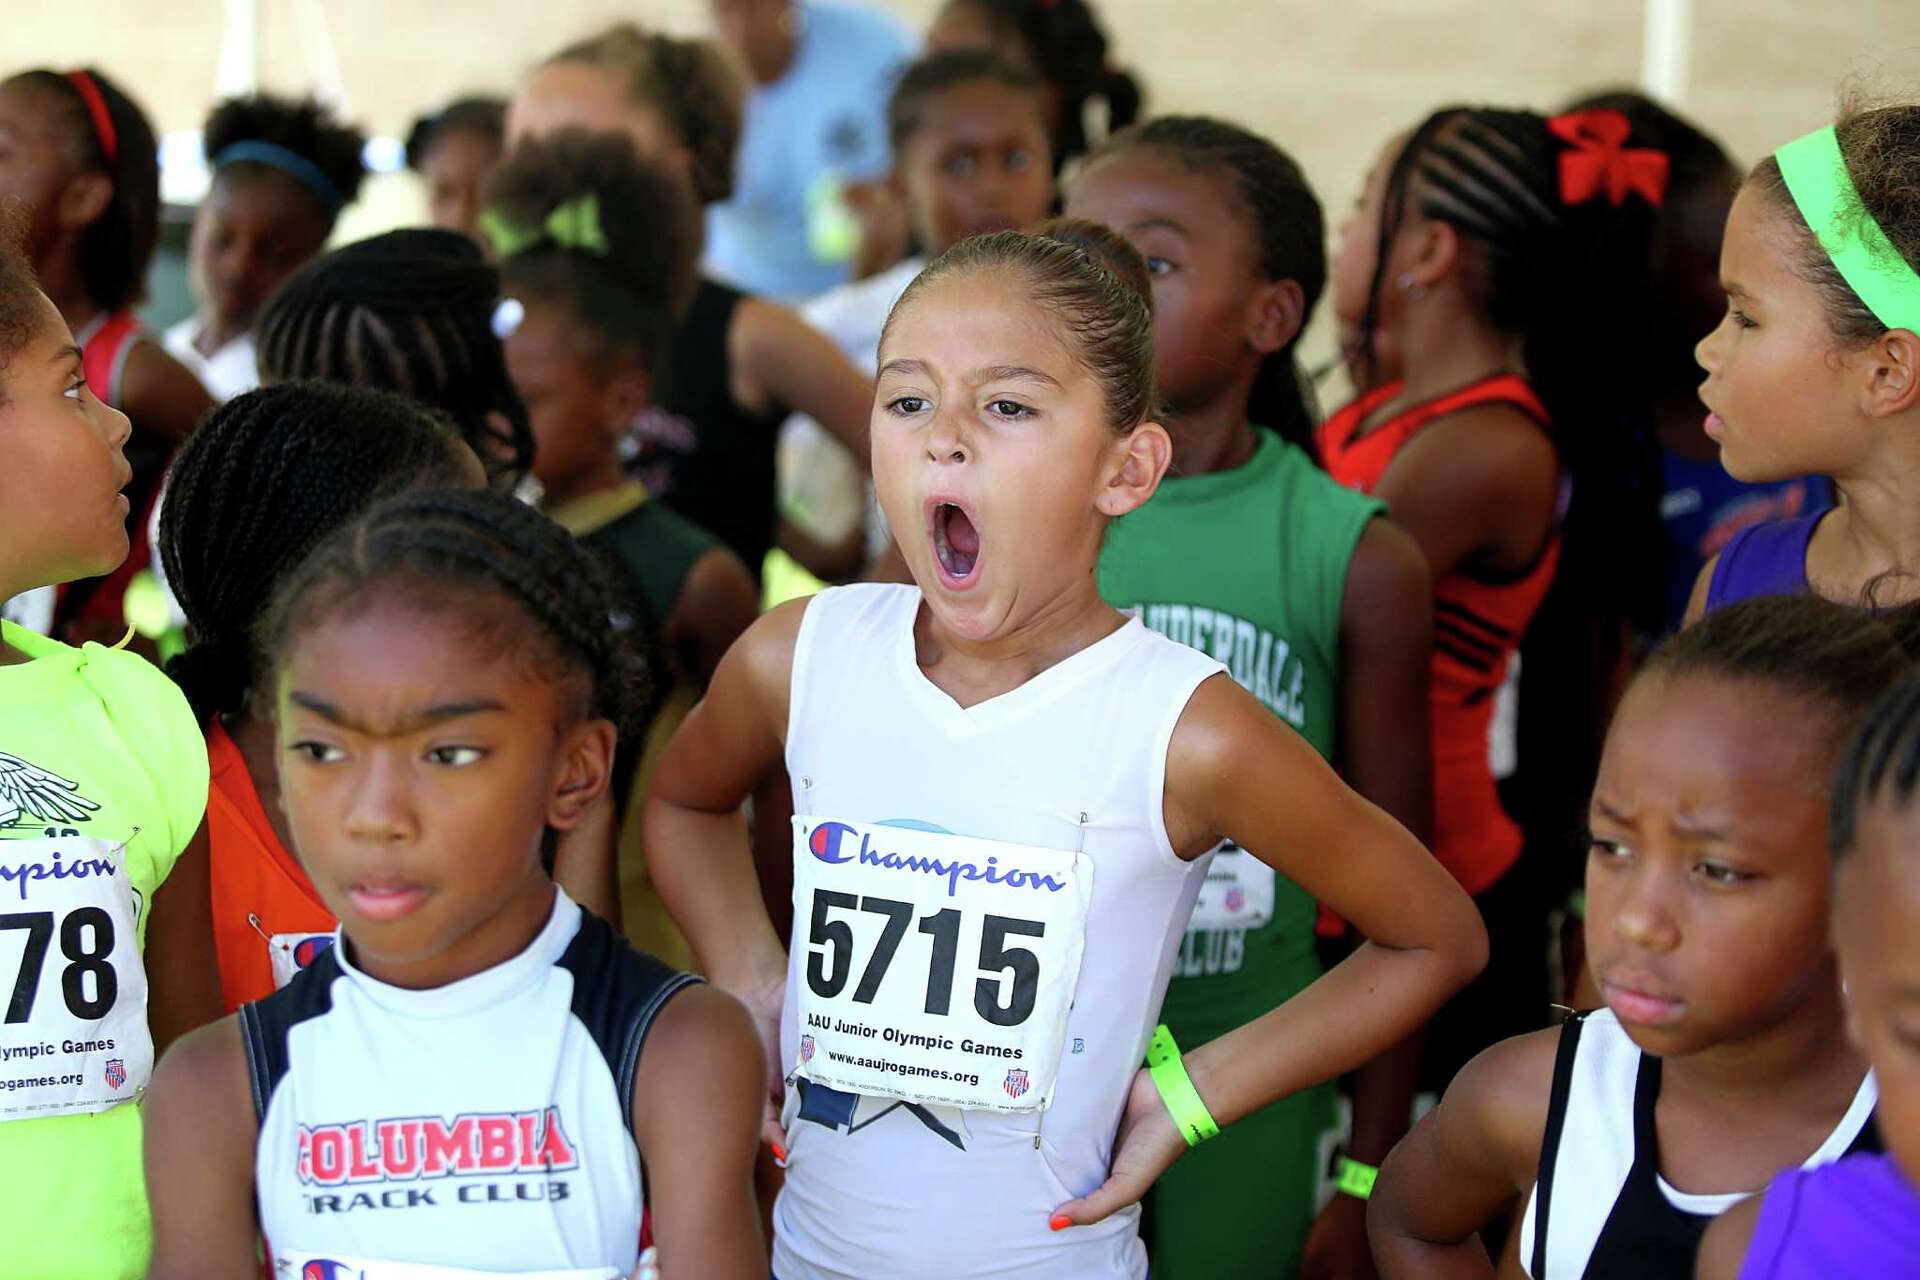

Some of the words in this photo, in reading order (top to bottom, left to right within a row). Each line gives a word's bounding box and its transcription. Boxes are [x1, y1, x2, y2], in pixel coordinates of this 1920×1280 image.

[1134, 604, 1304, 727] UDERDALE
[809, 822, 1066, 897] Champion
[0, 906, 118, 1025] 78
[806, 887, 1046, 1027] 5715
[1174, 928, 1246, 976] LUB
[62, 1039, 116, 1054] Games
[807, 1012, 831, 1030] AAU
[834, 1019, 878, 1039] Junior
[883, 1027, 954, 1050] Olympic
[960, 1039, 1023, 1060] Games
[828, 1050, 979, 1086] www.aaujrogames.org
[457, 1181, 570, 1204] CLUB
